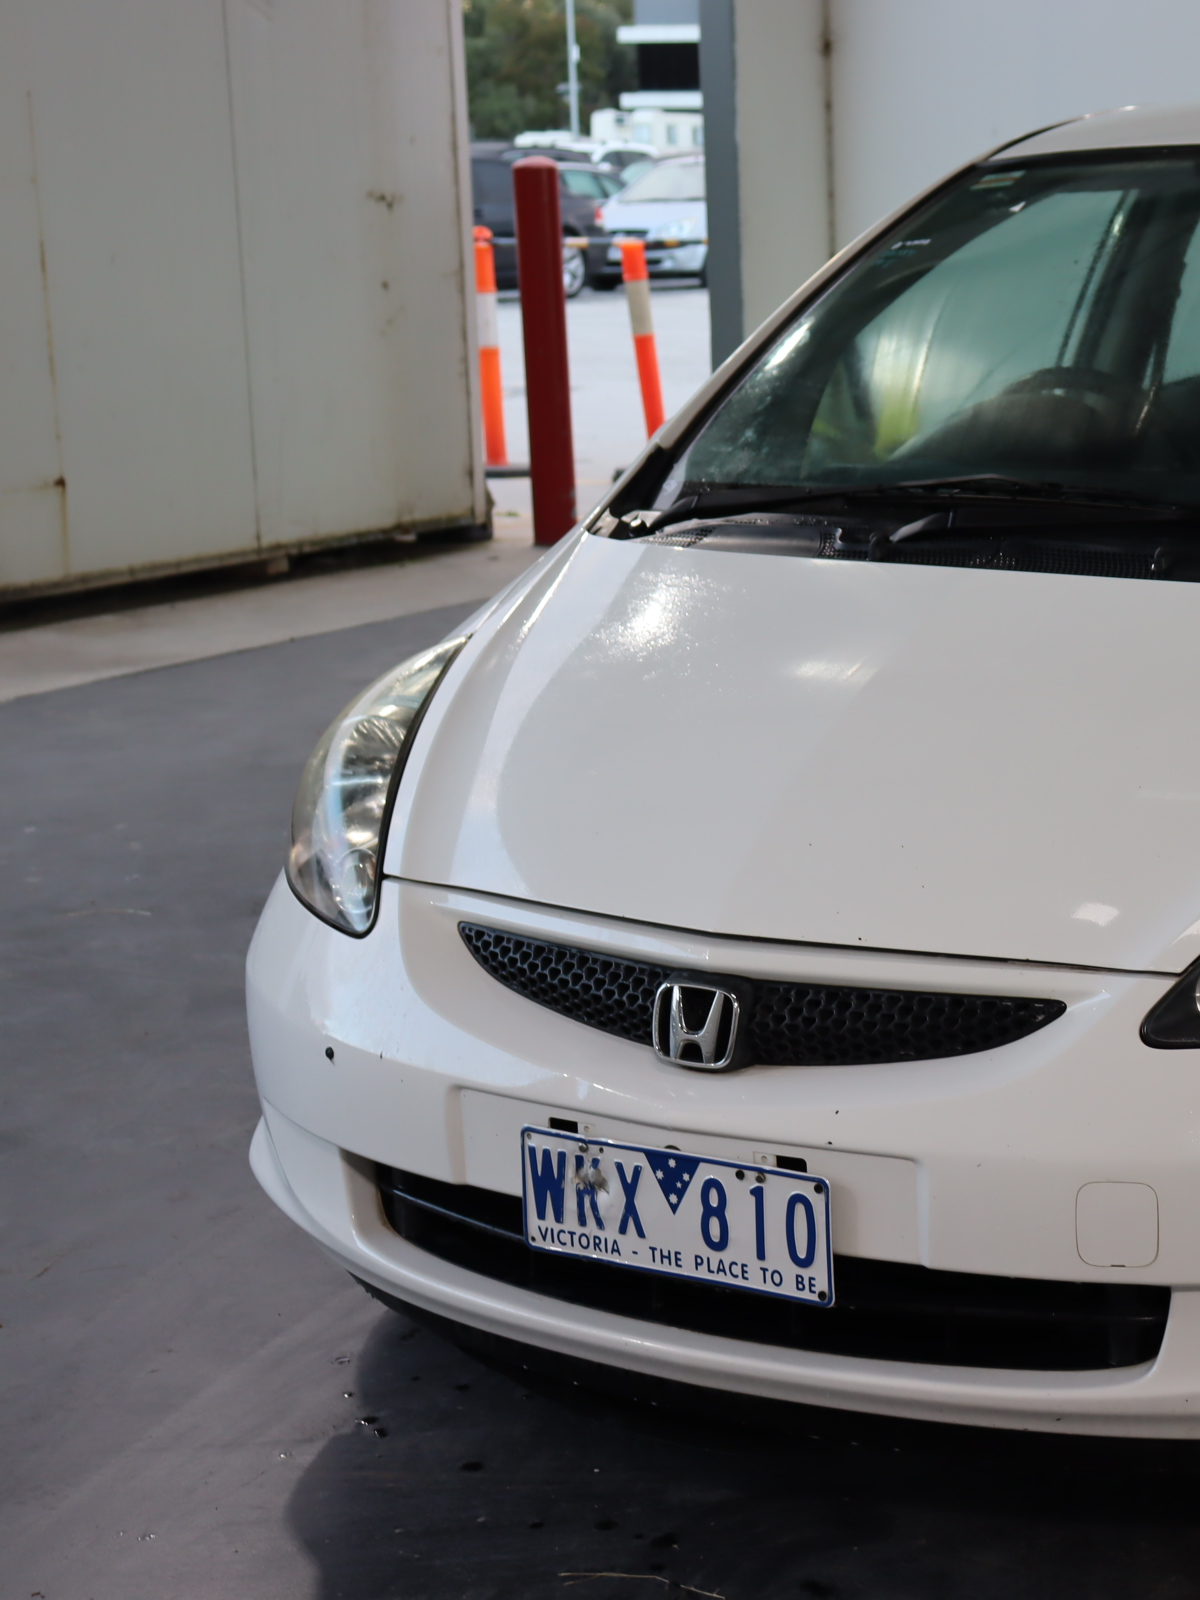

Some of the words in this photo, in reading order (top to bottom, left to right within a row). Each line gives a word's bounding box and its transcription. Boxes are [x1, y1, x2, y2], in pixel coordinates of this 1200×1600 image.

[537, 1225, 621, 1256] VICTORIA
[648, 1246, 683, 1268] THE
[694, 1254, 750, 1281] PLACE
[759, 1267, 784, 1287] TO
[795, 1274, 817, 1294] BE
[700, 1175, 817, 1268] 810
